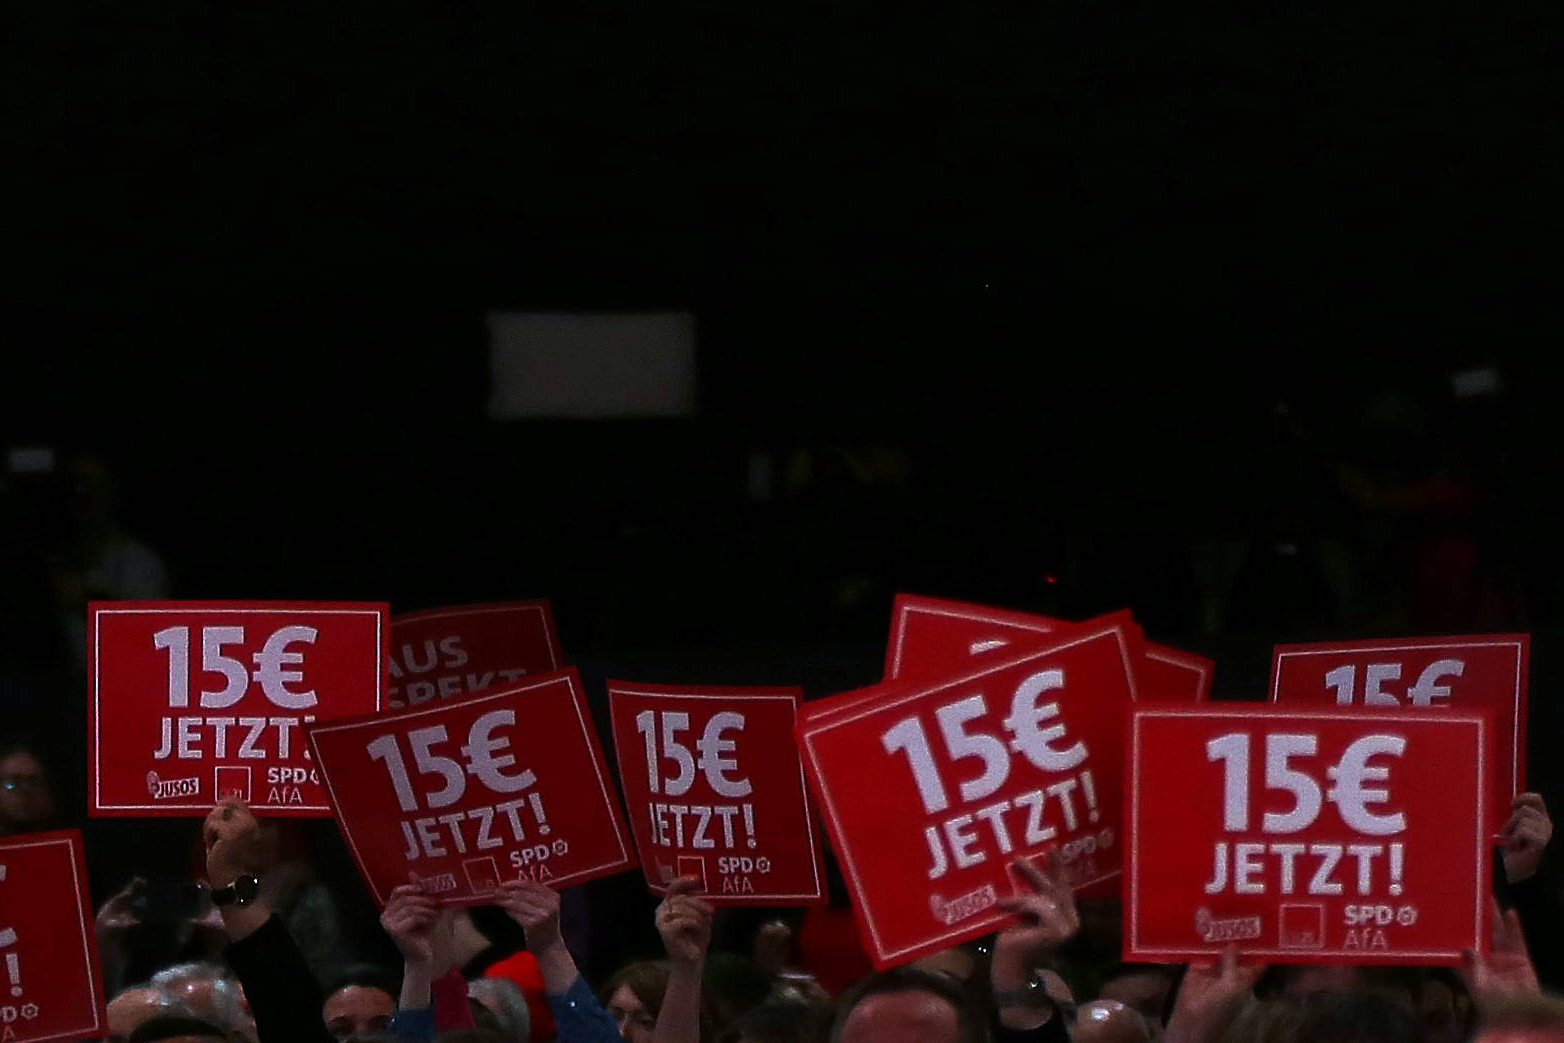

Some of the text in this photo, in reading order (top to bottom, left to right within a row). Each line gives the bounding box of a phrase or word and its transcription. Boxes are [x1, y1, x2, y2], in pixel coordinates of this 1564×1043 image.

[153, 625, 318, 709] 15€
[366, 709, 537, 812] 15€
[636, 710, 753, 797] 15€
[881, 669, 1089, 815] 15€
[156, 778, 200, 798] JUSOS
[267, 767, 307, 785] SPD
[267, 786, 303, 804] AfA
[1205, 732, 1408, 837] 15€
[400, 792, 551, 861] JETZT!
[649, 802, 757, 849] JETZT!
[924, 770, 1100, 880] JETZT!
[509, 844, 550, 868] SPD
[717, 856, 753, 875] SPD
[1204, 842, 1405, 898] JETZT!
[722, 876, 755, 893] AfA
[1343, 904, 1393, 926] SPD
